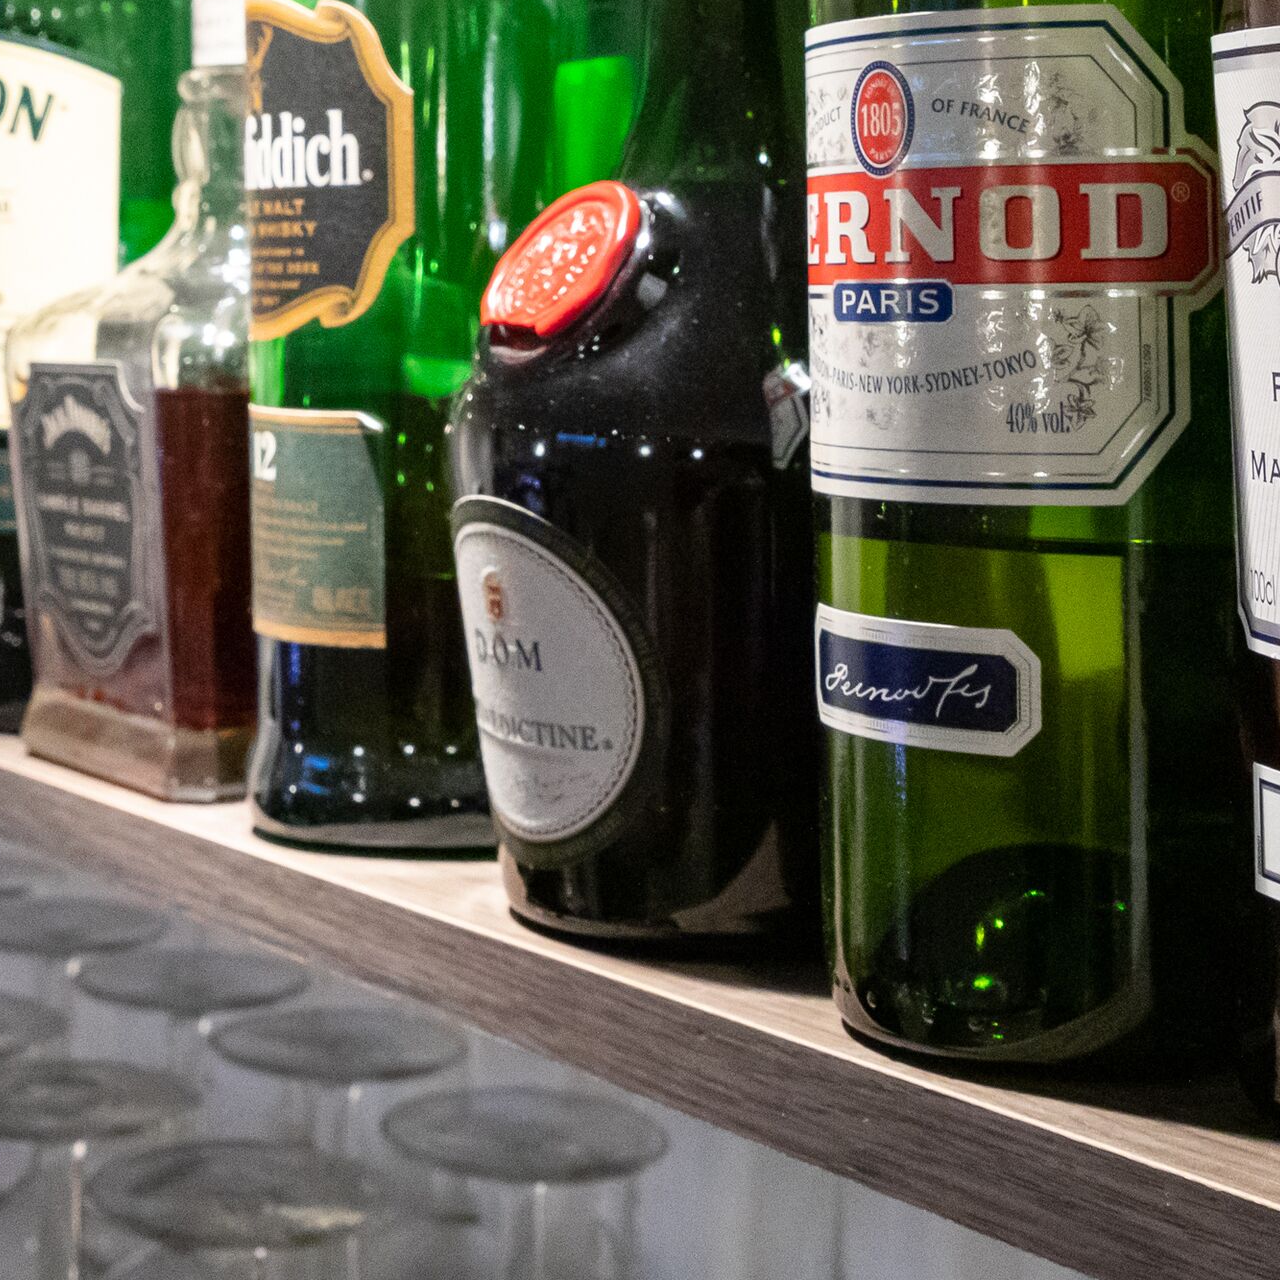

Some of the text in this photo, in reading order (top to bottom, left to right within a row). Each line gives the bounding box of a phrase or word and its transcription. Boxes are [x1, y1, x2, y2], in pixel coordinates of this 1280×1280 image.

[861, 102, 901, 137] 1805
[930, 97, 956, 116] OF
[960, 99, 1033, 134] FRANCE
[841, 288, 940, 315] PARIS
